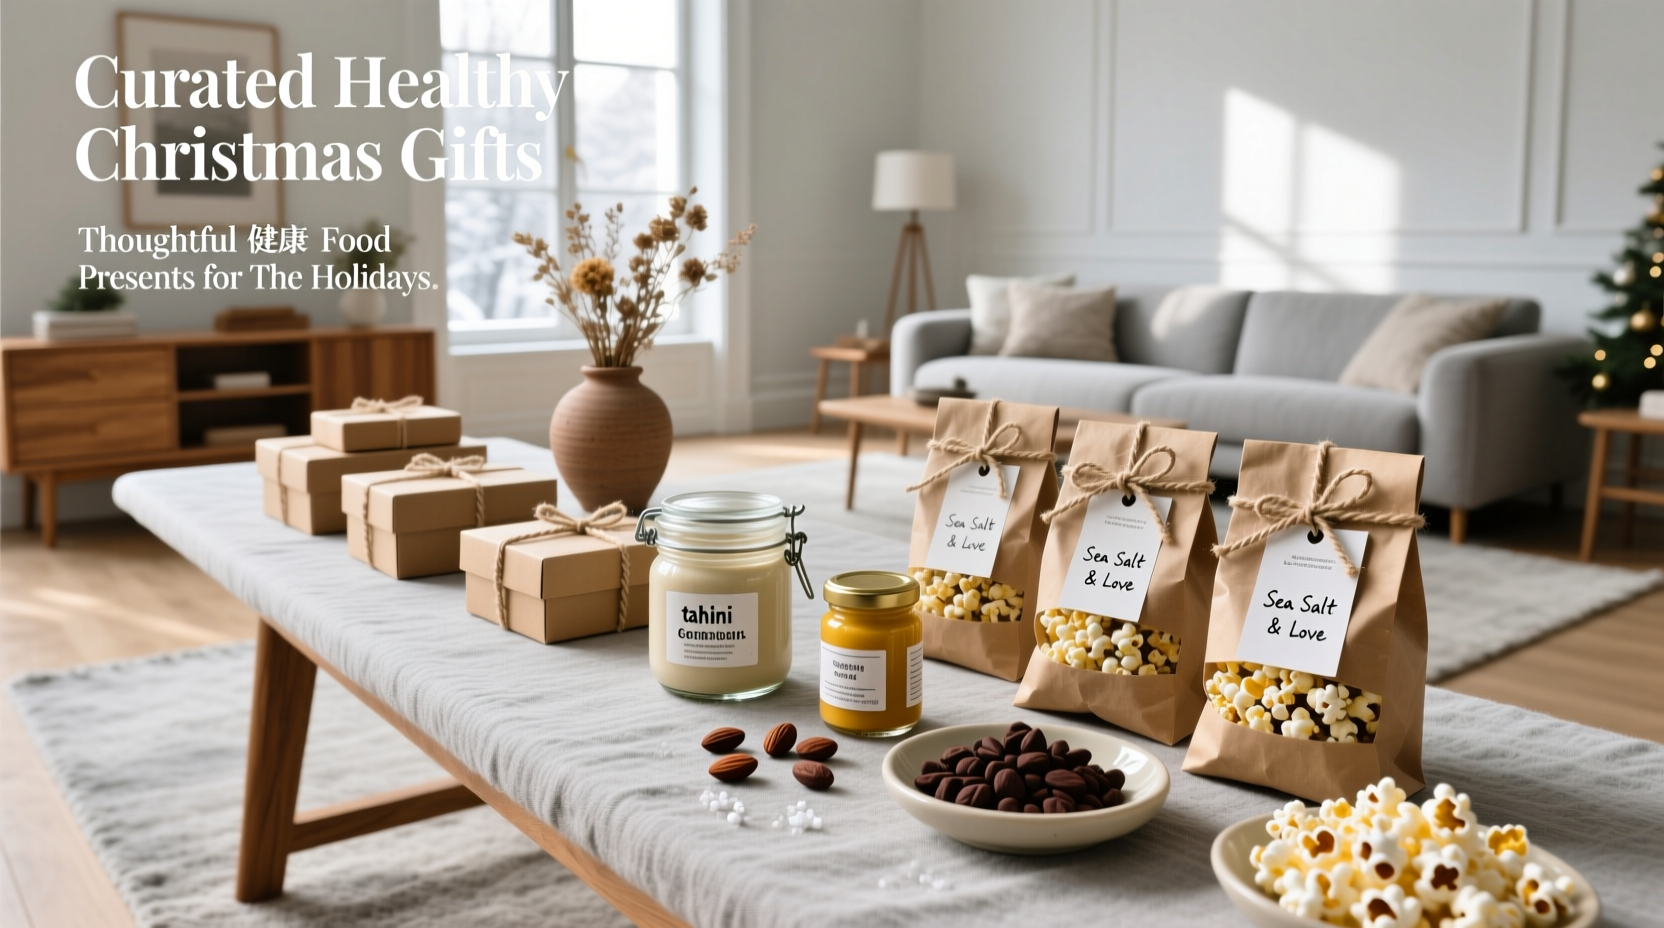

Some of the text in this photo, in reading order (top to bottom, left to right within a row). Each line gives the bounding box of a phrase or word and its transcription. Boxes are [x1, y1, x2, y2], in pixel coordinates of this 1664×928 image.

[945, 513, 996, 530] Sea Salt
[947, 534, 986, 551] & Love
[1083, 546, 1146, 568] Sea Salt
[1084, 569, 1134, 591] & Love
[1263, 590, 1338, 615] Sea Salt
[681, 605, 732, 624] tahini
[1267, 617, 1327, 641] & Love
